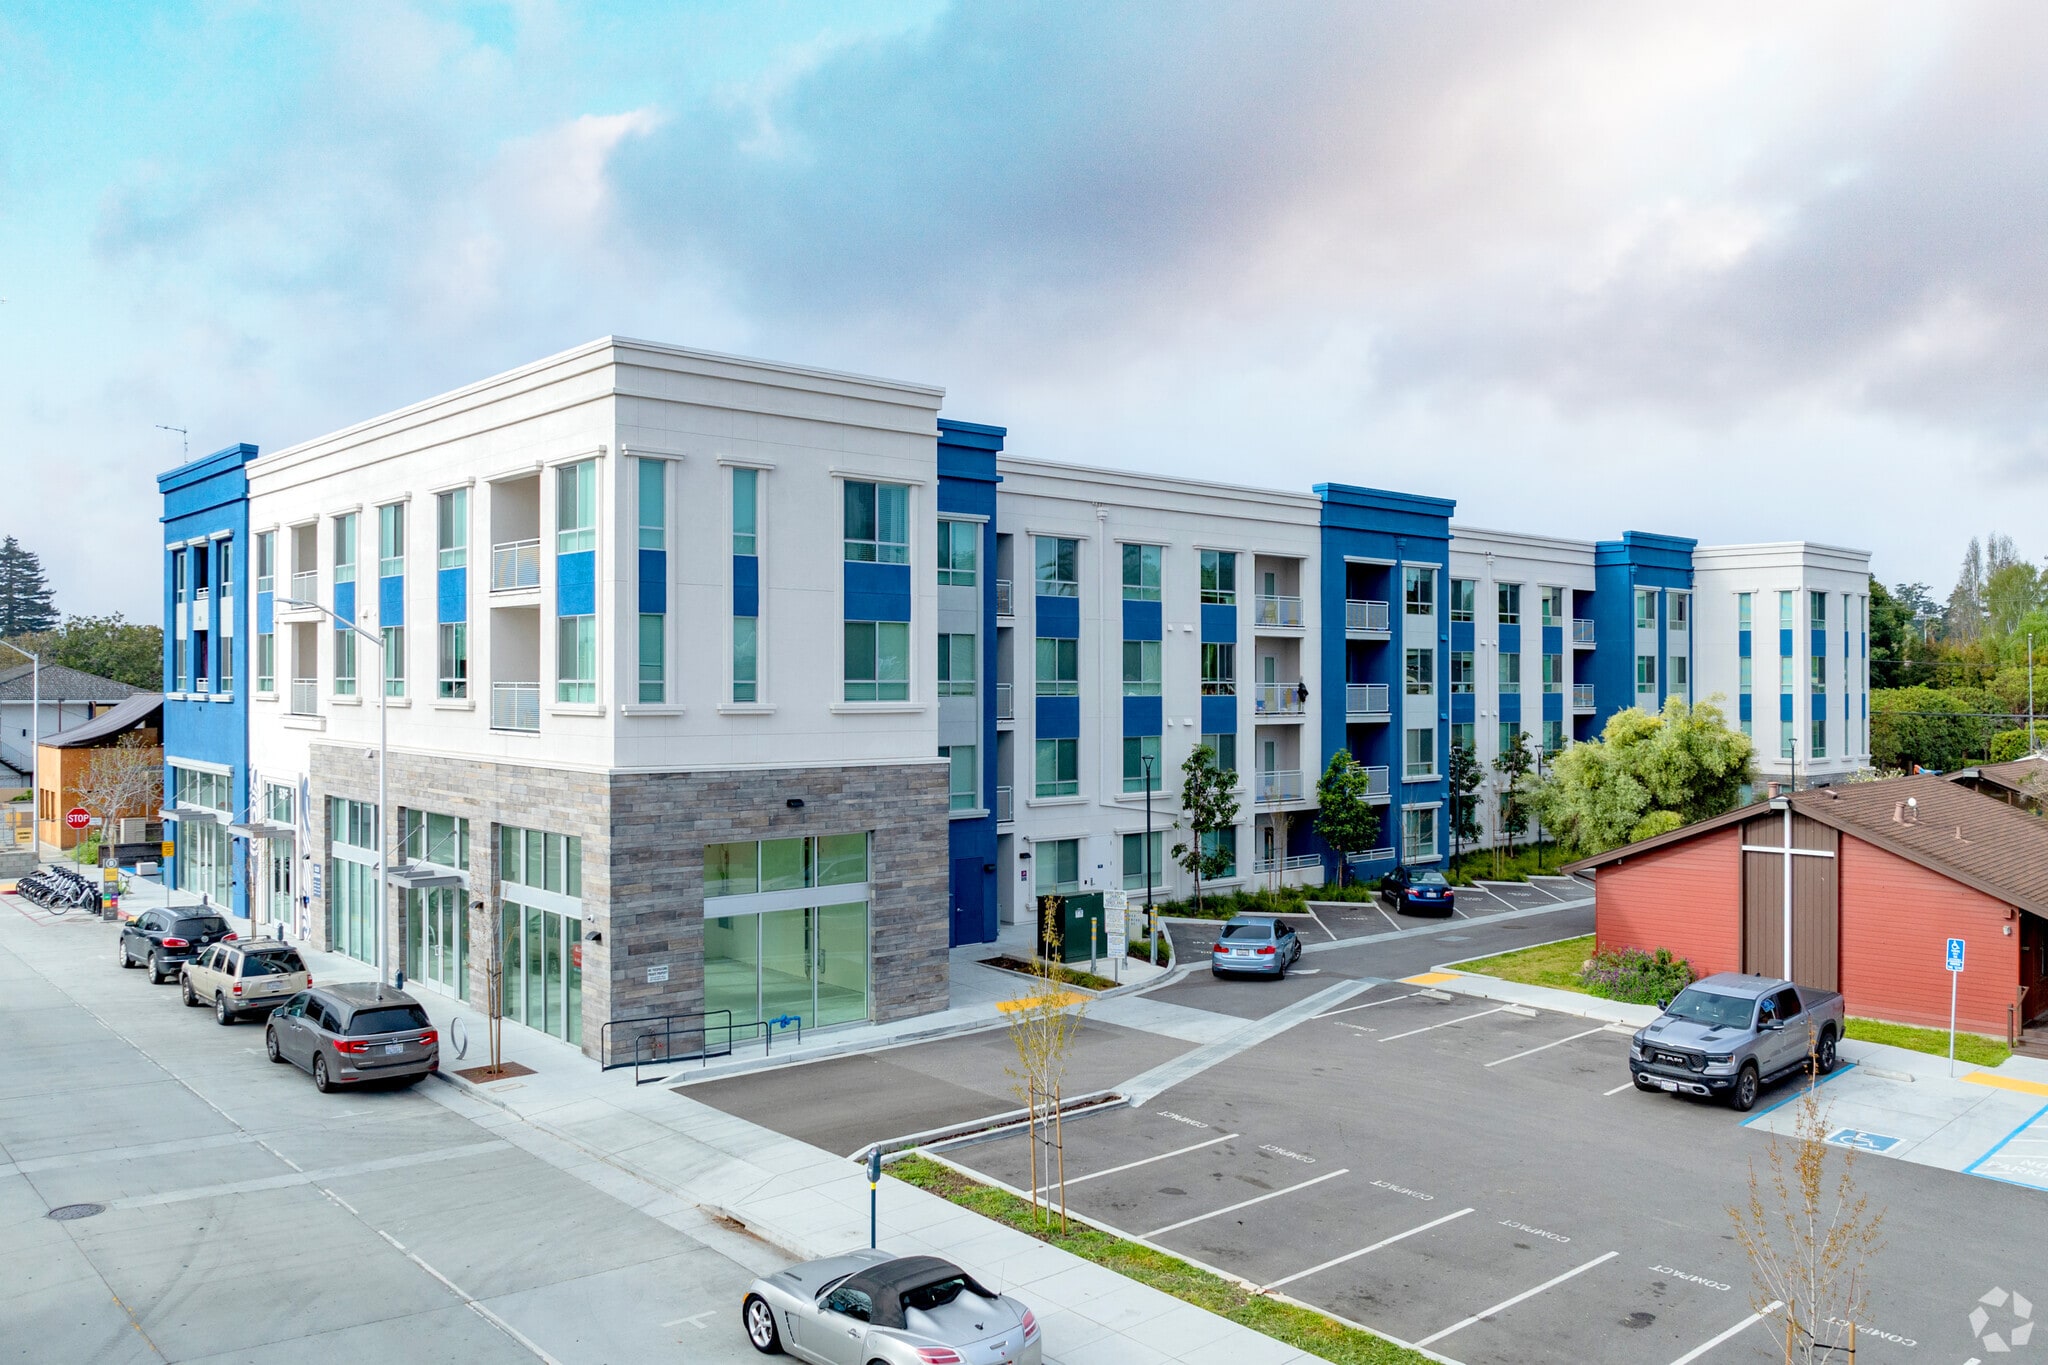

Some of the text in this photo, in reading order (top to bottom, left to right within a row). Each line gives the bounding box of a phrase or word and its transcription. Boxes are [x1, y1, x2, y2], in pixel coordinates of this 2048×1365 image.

[68, 814, 90, 823] STOP
[1657, 1054, 1684, 1063] RAM
[1157, 1110, 1209, 1128] COMPACT
[1259, 1144, 1316, 1163] COMPACT
[1369, 1180, 1433, 1200] COMPACT
[1498, 1219, 1571, 1243] COMPACT
[1648, 1264, 1731, 1291] COMPACT
